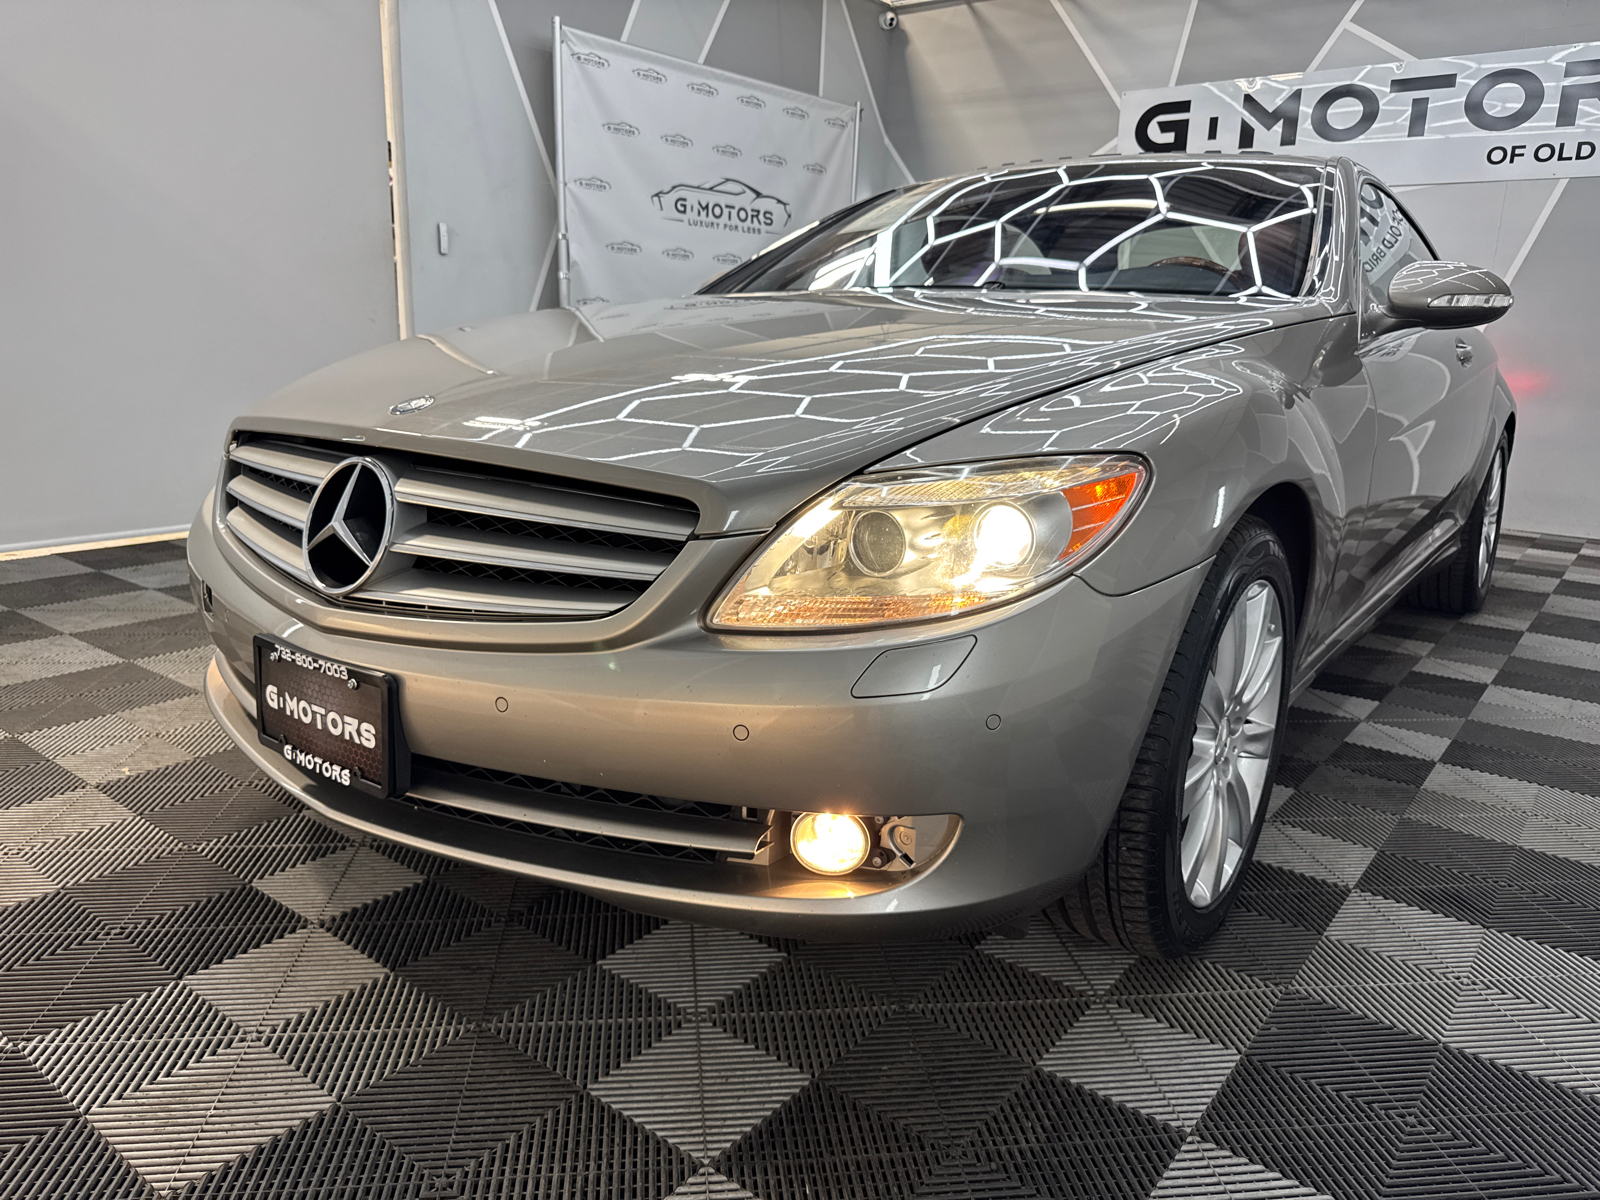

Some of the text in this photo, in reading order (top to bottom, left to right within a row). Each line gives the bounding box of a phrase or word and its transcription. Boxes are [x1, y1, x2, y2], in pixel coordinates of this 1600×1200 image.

[1486, 141, 1596, 165] OF OLD
[688, 218, 762, 235] LUXURY FOR LESS
[274, 644, 348, 680] 732-800-7003
